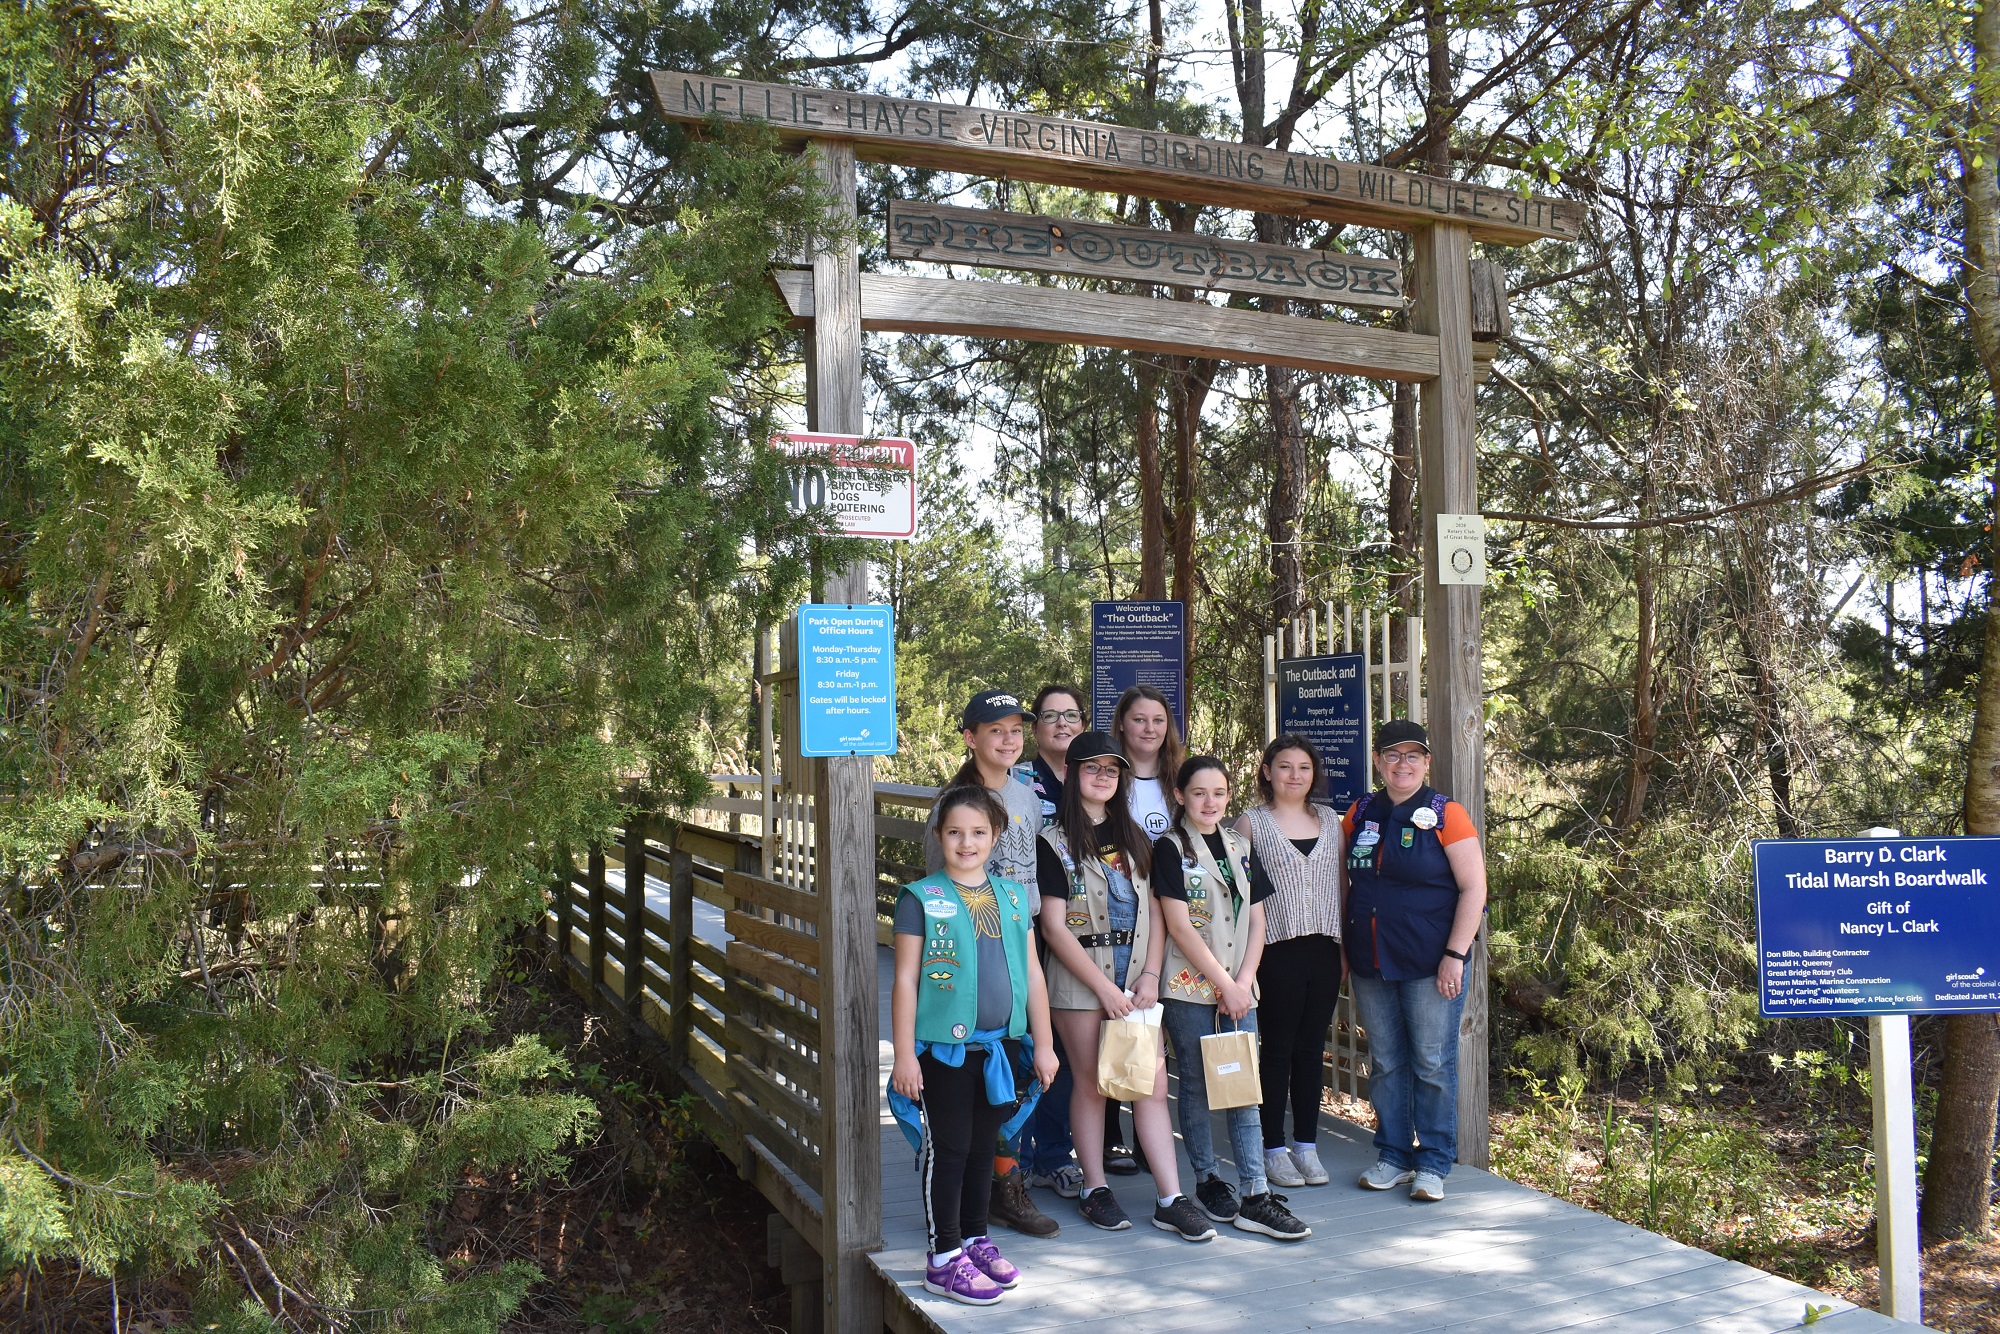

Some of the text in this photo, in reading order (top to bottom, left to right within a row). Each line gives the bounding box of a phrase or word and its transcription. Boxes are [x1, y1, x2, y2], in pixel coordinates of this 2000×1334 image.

[683, 79, 1566, 233] NELLIE HAYSE VIRGINIA BIRDING AND WILDLIFE SITE
[893, 213, 1401, 298] THE OUTBACK
[831, 481, 881, 492] BICYCLES
[831, 492, 860, 502] DOGS
[830, 503, 886, 514] LOITERING
[831, 618, 853, 626] Open
[855, 618, 883, 627] During
[813, 646, 881, 654] Monday-Thursday
[836, 670, 860, 678] Friday
[1286, 664, 1356, 682] The Outback and
[1298, 684, 1342, 699] Boardwalk
[1307, 708, 1328, 716] Property
[1325, 756, 1335, 764] This
[1150, 819, 1163, 828] HF
[1825, 845, 1947, 867] Barry D. Clark
[1786, 869, 1987, 888] Tidal Marsh Boardwalk
[1866, 901, 1910, 915] Gift of
[1840, 919, 1939, 937] Nancy L. Clark
[932, 940, 953, 948] 673
[1803, 950, 1831, 958] Building
[1789, 969, 1811, 978] Bridge
[1946, 973, 1957, 982] girl
[1809, 997, 1833, 1006] Facility
